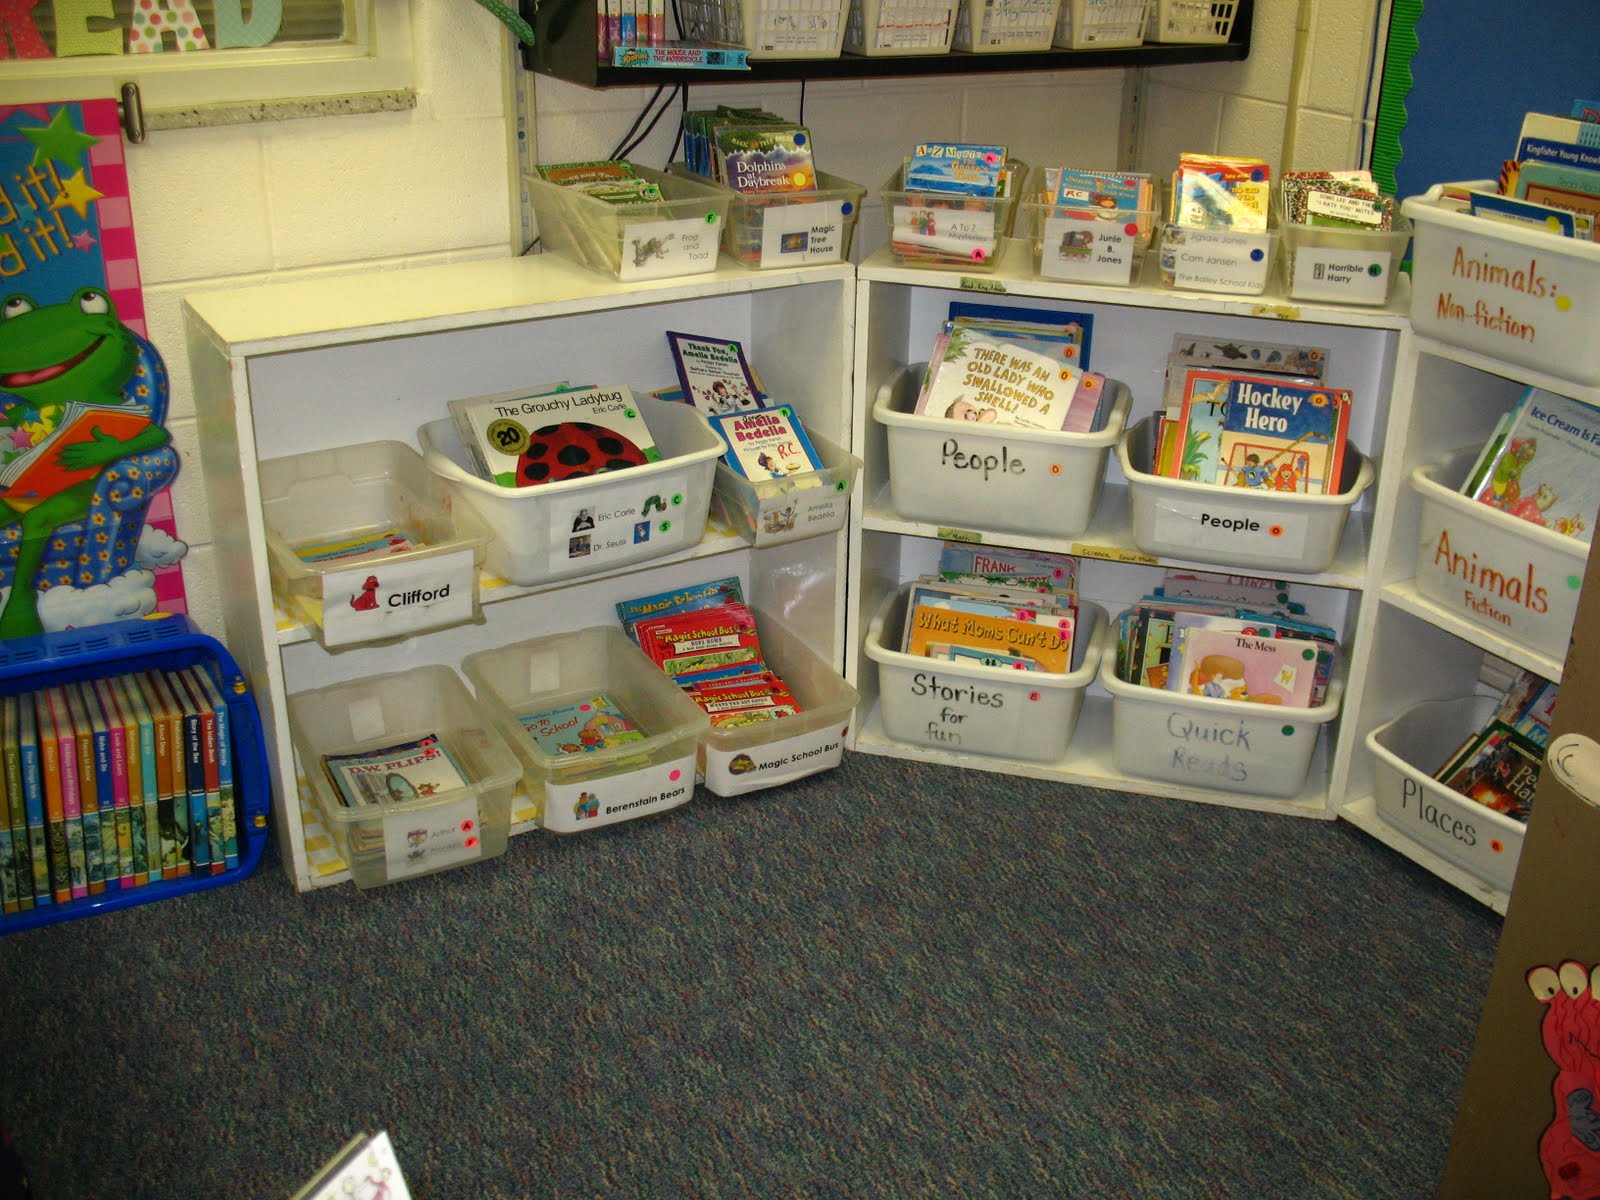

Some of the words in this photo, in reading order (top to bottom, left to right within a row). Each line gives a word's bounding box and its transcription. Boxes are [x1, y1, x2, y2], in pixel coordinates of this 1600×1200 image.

[1526, 144, 1558, 156] Kingfisher
[1560, 149, 1579, 162] Young
[737, 161, 786, 174] Dolphins
[747, 172, 755, 180] at
[15, 158, 70, 210] it!
[738, 176, 790, 189] Daybreak
[24, 209, 75, 261] it!
[811, 224, 836, 235] Magic
[960, 224, 971, 232] To
[682, 233, 699, 243] Frog
[811, 236, 828, 244] Tree
[1099, 234, 1123, 243] Junie
[1190, 233, 1218, 242] Jigsaw
[1222, 235, 1248, 245] Jones
[688, 252, 709, 260] Toad
[810, 245, 834, 254] House
[1097, 255, 1123, 265] Jones
[1181, 253, 1204, 262] Cam
[1206, 256, 1237, 266] Jansen
[1328, 264, 1363, 273] Horrible
[1179, 273, 1192, 281] The
[1195, 276, 1218, 285] Bailey
[1220, 279, 1246, 287] School
[1327, 275, 1351, 284] Harry
[1437, 292, 1536, 343] Non-fiction
[683, 350, 709, 359] Amelia
[710, 354, 738, 363] Bedelia
[688, 343, 711, 352] Thank
[712, 347, 729, 356] You,
[974, 347, 1008, 365] THERE
[1009, 356, 1033, 372] WAS
[1035, 366, 1051, 381] AN
[967, 361, 992, 375] OLD
[993, 365, 1026, 386] LADY
[1026, 380, 1055, 401] WHO
[963, 374, 1038, 409] SWALLOWED
[1040, 404, 1050, 415] A
[974, 391, 1020, 414] SHELL!
[1237, 383, 1303, 415] Hockey
[494, 406, 520, 418] The
[521, 399, 571, 414] Grouchy
[571, 391, 623, 407] Ladybug
[592, 406, 607, 415] Eric
[607, 403, 627, 412] Carle
[734, 415, 780, 431] Amelia
[1244, 408, 1288, 433] Hero
[1531, 406, 1547, 421] Ice
[1547, 414, 1581, 436] Cream
[1581, 428, 1590, 441] Is
[496, 426, 521, 447] 20
[735, 425, 787, 442] Bedelia
[942, 438, 1026, 481] People
[598, 513, 612, 522] Eric
[614, 508, 636, 519] Carle
[808, 502, 833, 512] Amelia
[808, 511, 835, 522] Bedelia
[1201, 514, 1260, 532] People
[593, 542, 605, 552] Dr.
[606, 538, 627, 549] Seuss
[1082, 548, 1111, 559] Science
[974, 555, 1017, 573] FRANK
[1435, 530, 1549, 614] Animals
[387, 584, 450, 608] Clifford
[1464, 590, 1512, 626] Fiction
[665, 632, 691, 643] Magic
[692, 628, 718, 639] School
[719, 626, 734, 634] Bus
[919, 612, 960, 633] What
[962, 618, 1004, 641] Moms
[1006, 626, 1047, 649] Can't
[1049, 634, 1070, 652] Do
[1236, 638, 1253, 649] The
[1255, 641, 1277, 652] Mess
[695, 694, 722, 702] Magic
[723, 692, 749, 700] School
[911, 673, 1005, 709] Stories
[217, 711, 225, 723] The
[939, 707, 968, 725] for
[190, 719, 198, 734] Story
[218, 723, 226, 740] Magic
[540, 716, 579, 736] School
[925, 722, 962, 745] fun
[1167, 712, 1251, 749] Quick
[347, 765, 381, 774] D.W.
[385, 750, 441, 770] FLIPS!
[758, 756, 788, 771] Magic
[791, 746, 823, 762] School
[824, 741, 839, 752] Bus
[1171, 747, 1249, 782] Reads
[101, 764, 107, 772] Do
[606, 796, 658, 815] Berenstain
[660, 787, 685, 801] Bears
[1402, 778, 1477, 847] Places
